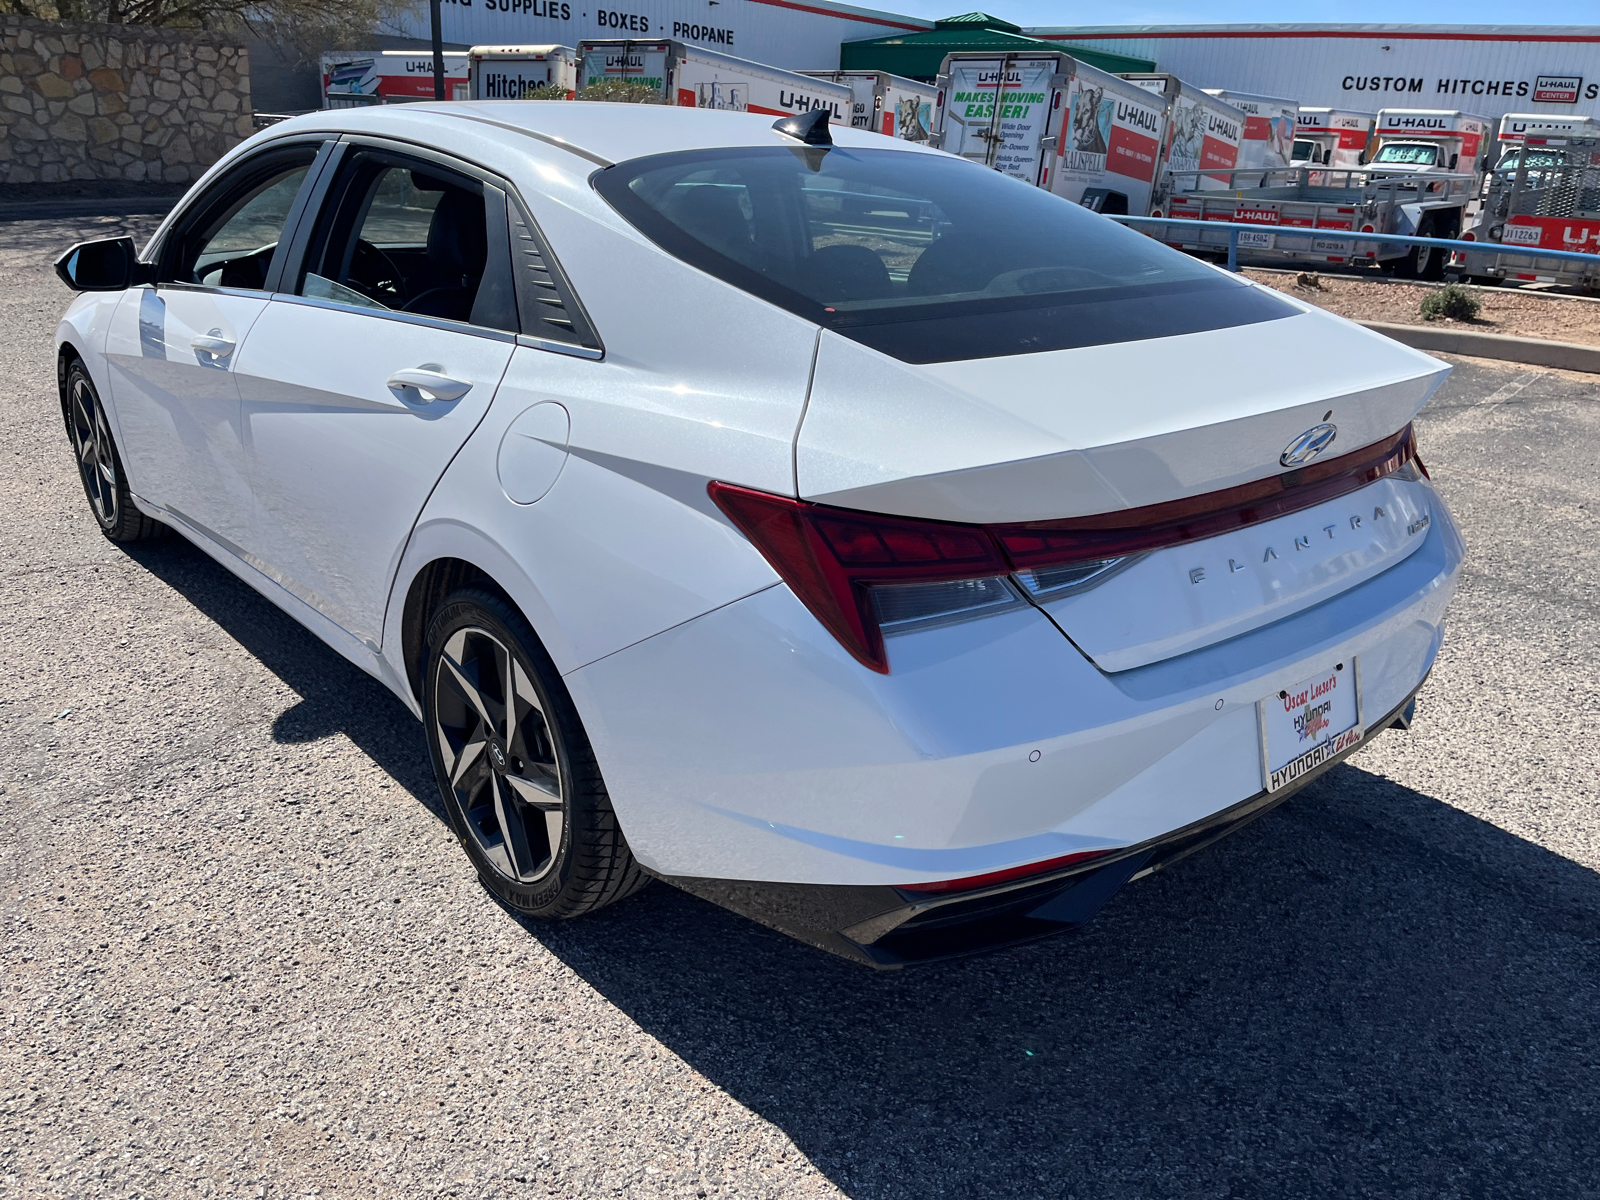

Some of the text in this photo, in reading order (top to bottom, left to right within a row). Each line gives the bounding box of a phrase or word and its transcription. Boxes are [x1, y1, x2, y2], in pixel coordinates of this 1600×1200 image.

[485, 0, 734, 45] SUPPLIES BOXES PROPANE
[406, 61, 449, 73] U-HAL
[606, 56, 643, 66] U-HAUL
[1342, 76, 1529, 97] CUSTOM HITCHES
[1539, 81, 1576, 89] U-HAUL
[954, 92, 1045, 104] MAKES MOVING
[852, 115, 869, 127] CITY
[1117, 101, 1157, 133] U-HAUL
[1388, 117, 1447, 129] U-HAUL
[1208, 115, 1238, 141] U-HAUL
[1000, 131, 1024, 140] Opening
[1013, 155, 1035, 163] Queen-
[1062, 150, 1102, 172] KALISPELL
[995, 162, 1008, 170] Size
[1234, 210, 1277, 221] U-HAUL
[1189, 506, 1385, 585] ELANTRA
[1284, 674, 1337, 712] Oscar Leeser's
[1294, 700, 1331, 730] HYUNDAI
[1271, 746, 1325, 790] HYUNDAI
